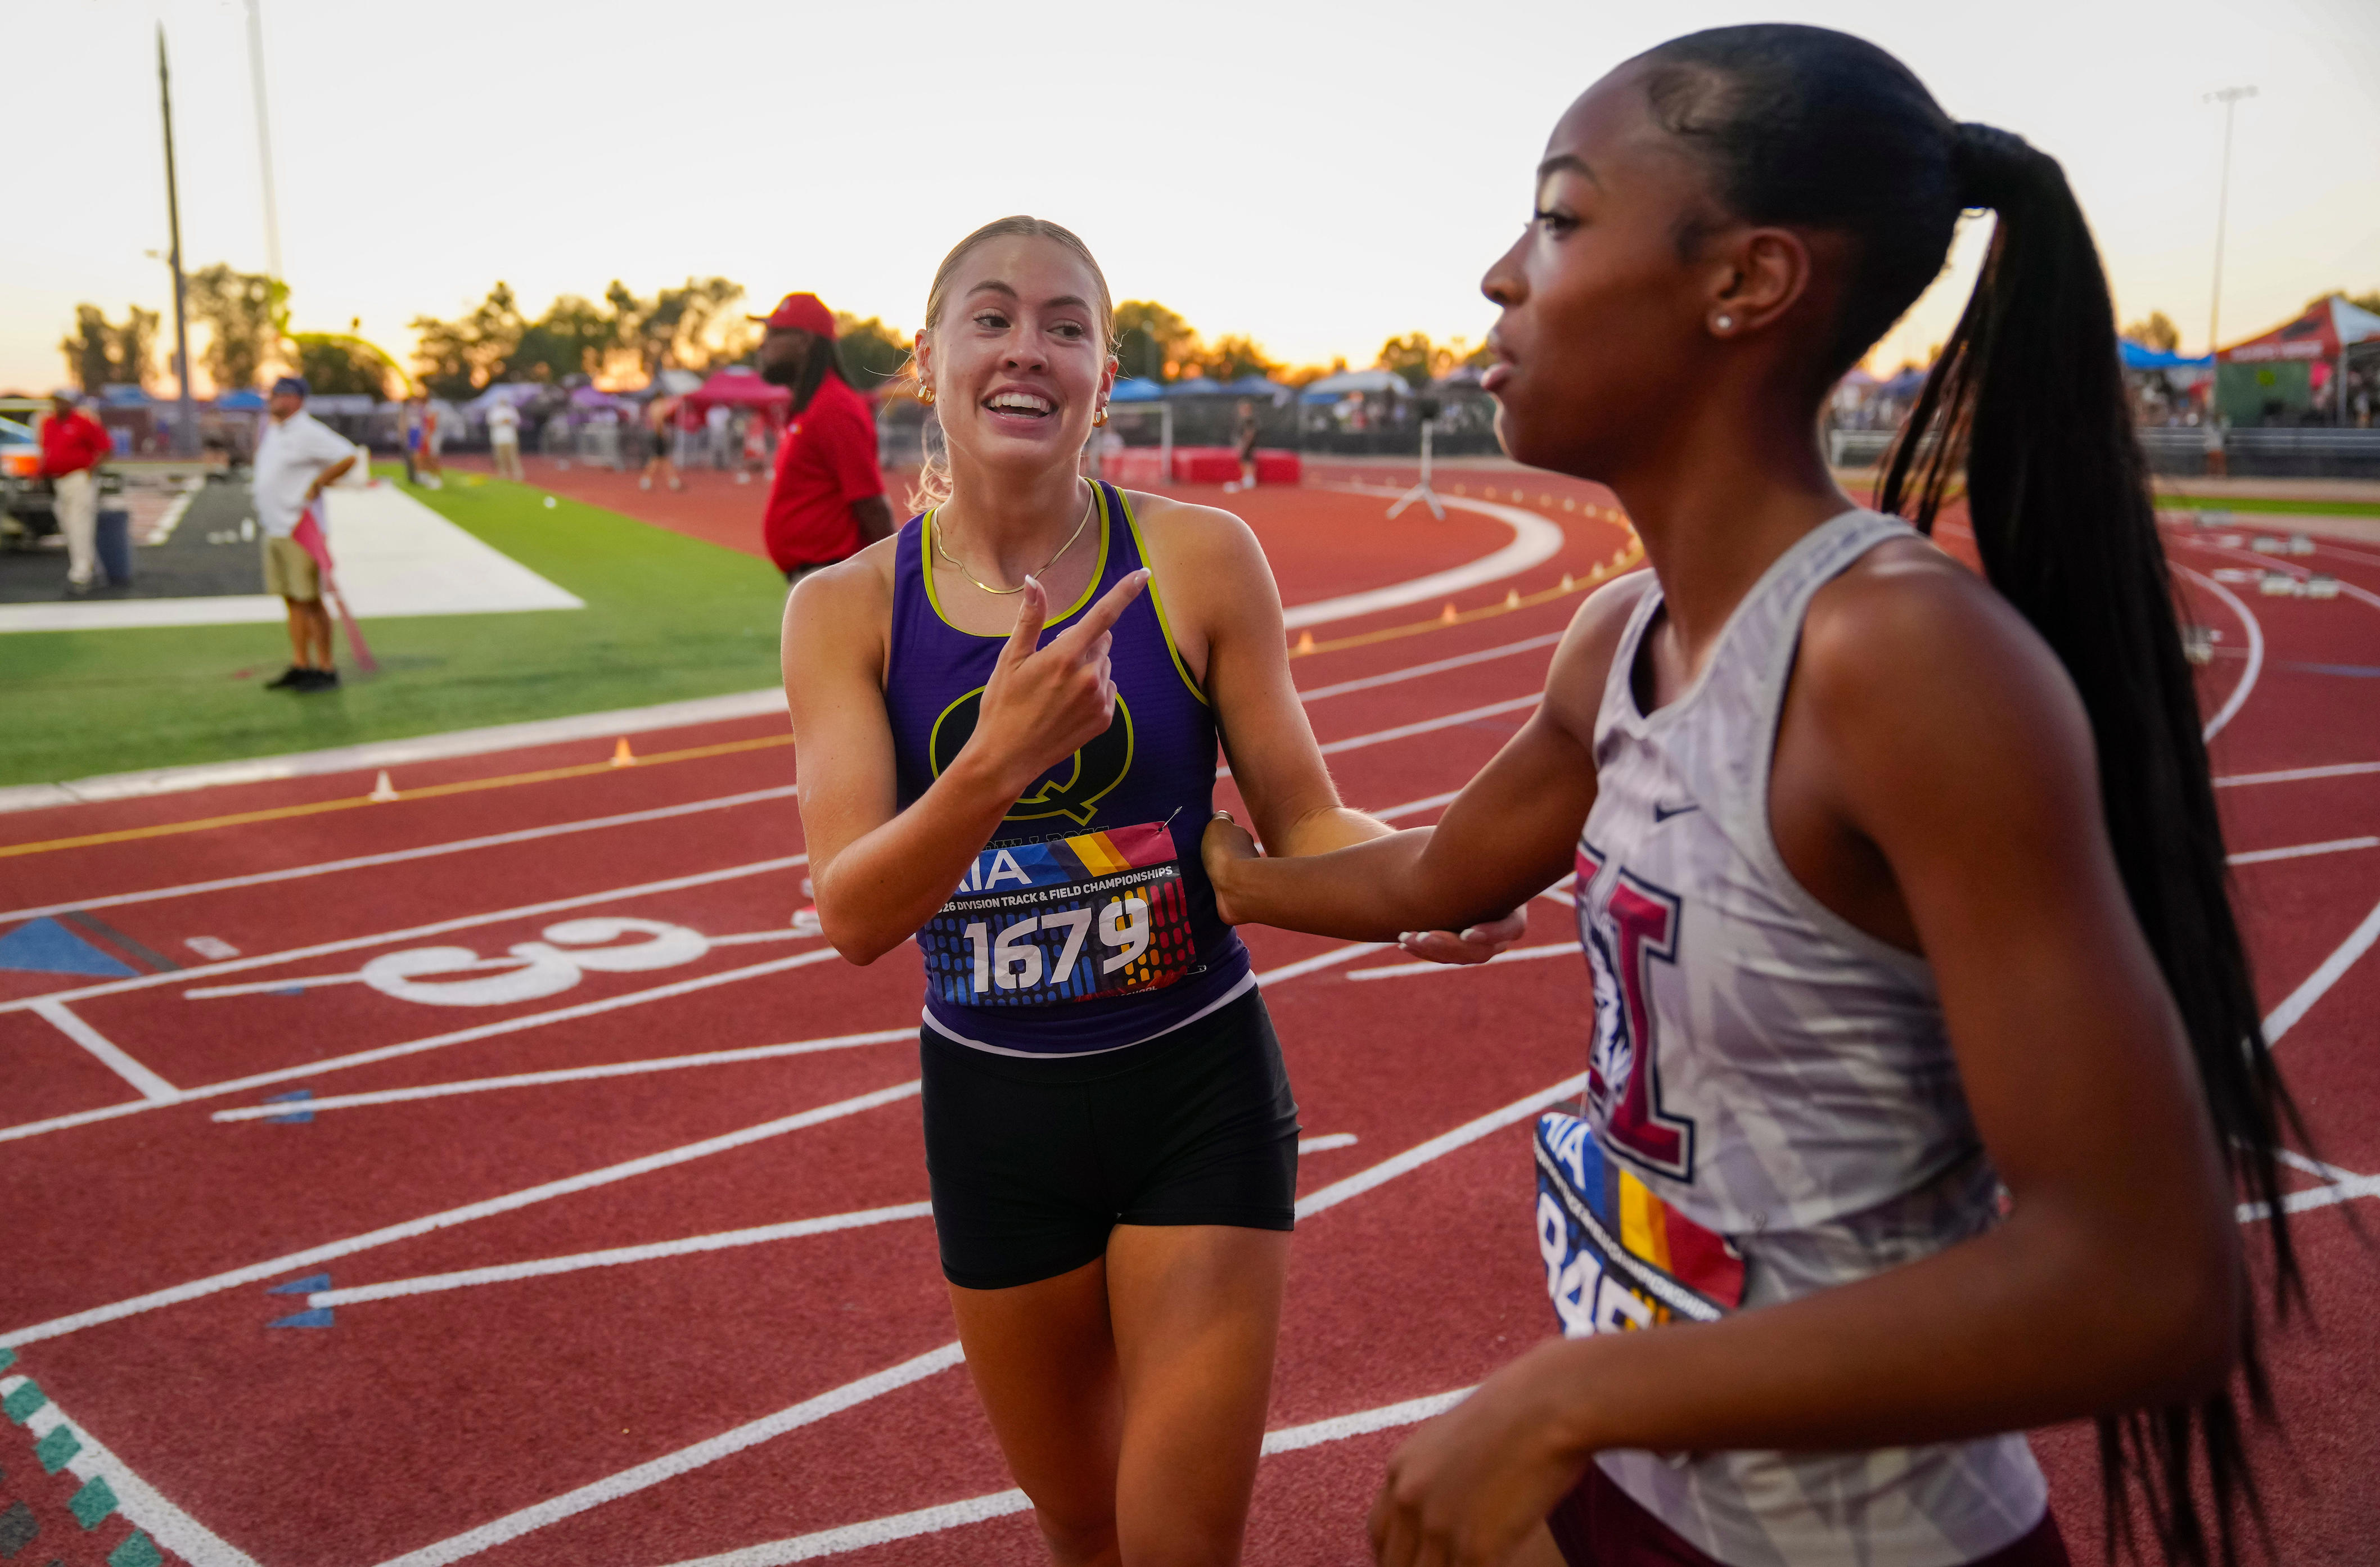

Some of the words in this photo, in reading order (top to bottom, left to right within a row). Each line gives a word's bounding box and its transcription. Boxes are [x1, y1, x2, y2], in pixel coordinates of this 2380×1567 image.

[957, 898, 1000, 911] DIVISION
[1001, 892, 1038, 906] TRACK
[1039, 891, 1048, 901] &
[1049, 886, 1082, 900] FIELD
[1083, 865, 1173, 895] CHAMPIONSHIPS
[963, 897, 1150, 994] 1679
